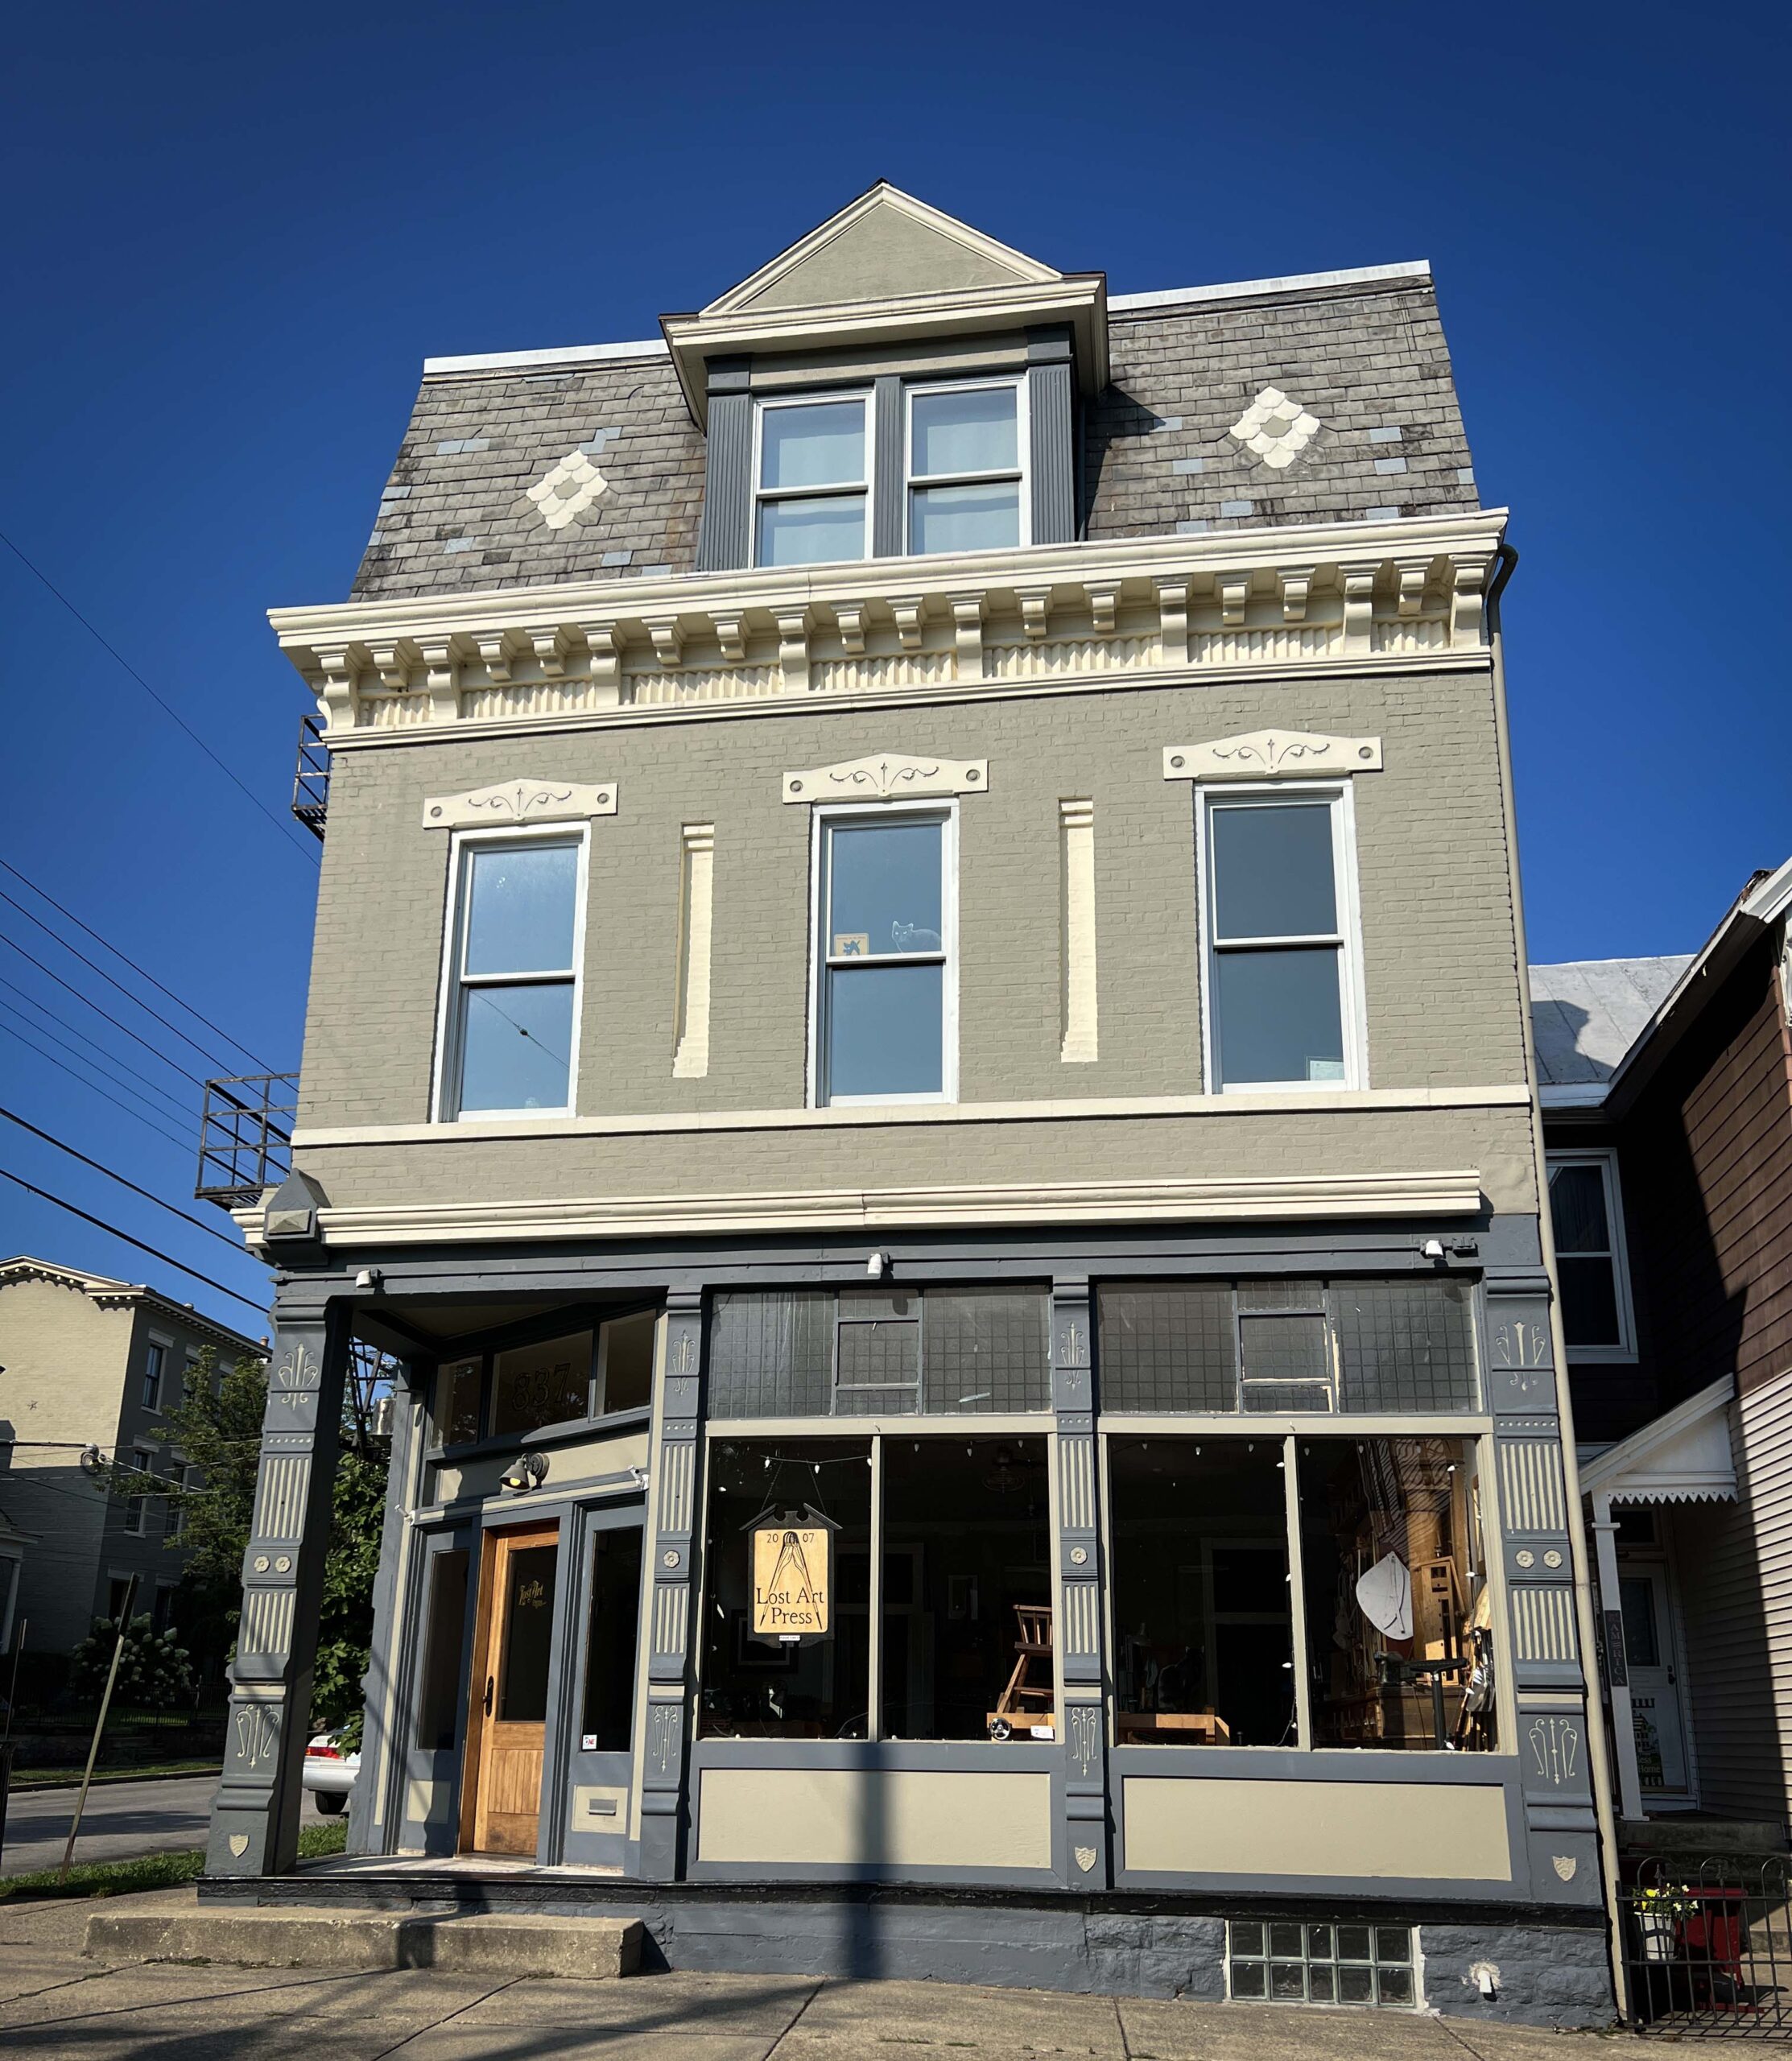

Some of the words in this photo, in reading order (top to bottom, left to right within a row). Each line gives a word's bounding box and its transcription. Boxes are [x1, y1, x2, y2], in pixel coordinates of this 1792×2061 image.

[512, 1362, 571, 1411] 837
[766, 1534, 778, 1543] 20
[803, 1533, 815, 1543] 07
[756, 1588, 791, 1605] Lost
[796, 1587, 824, 1604] Art
[771, 1607, 812, 1625] Press
[1610, 1623, 1625, 1684] AMERICA
